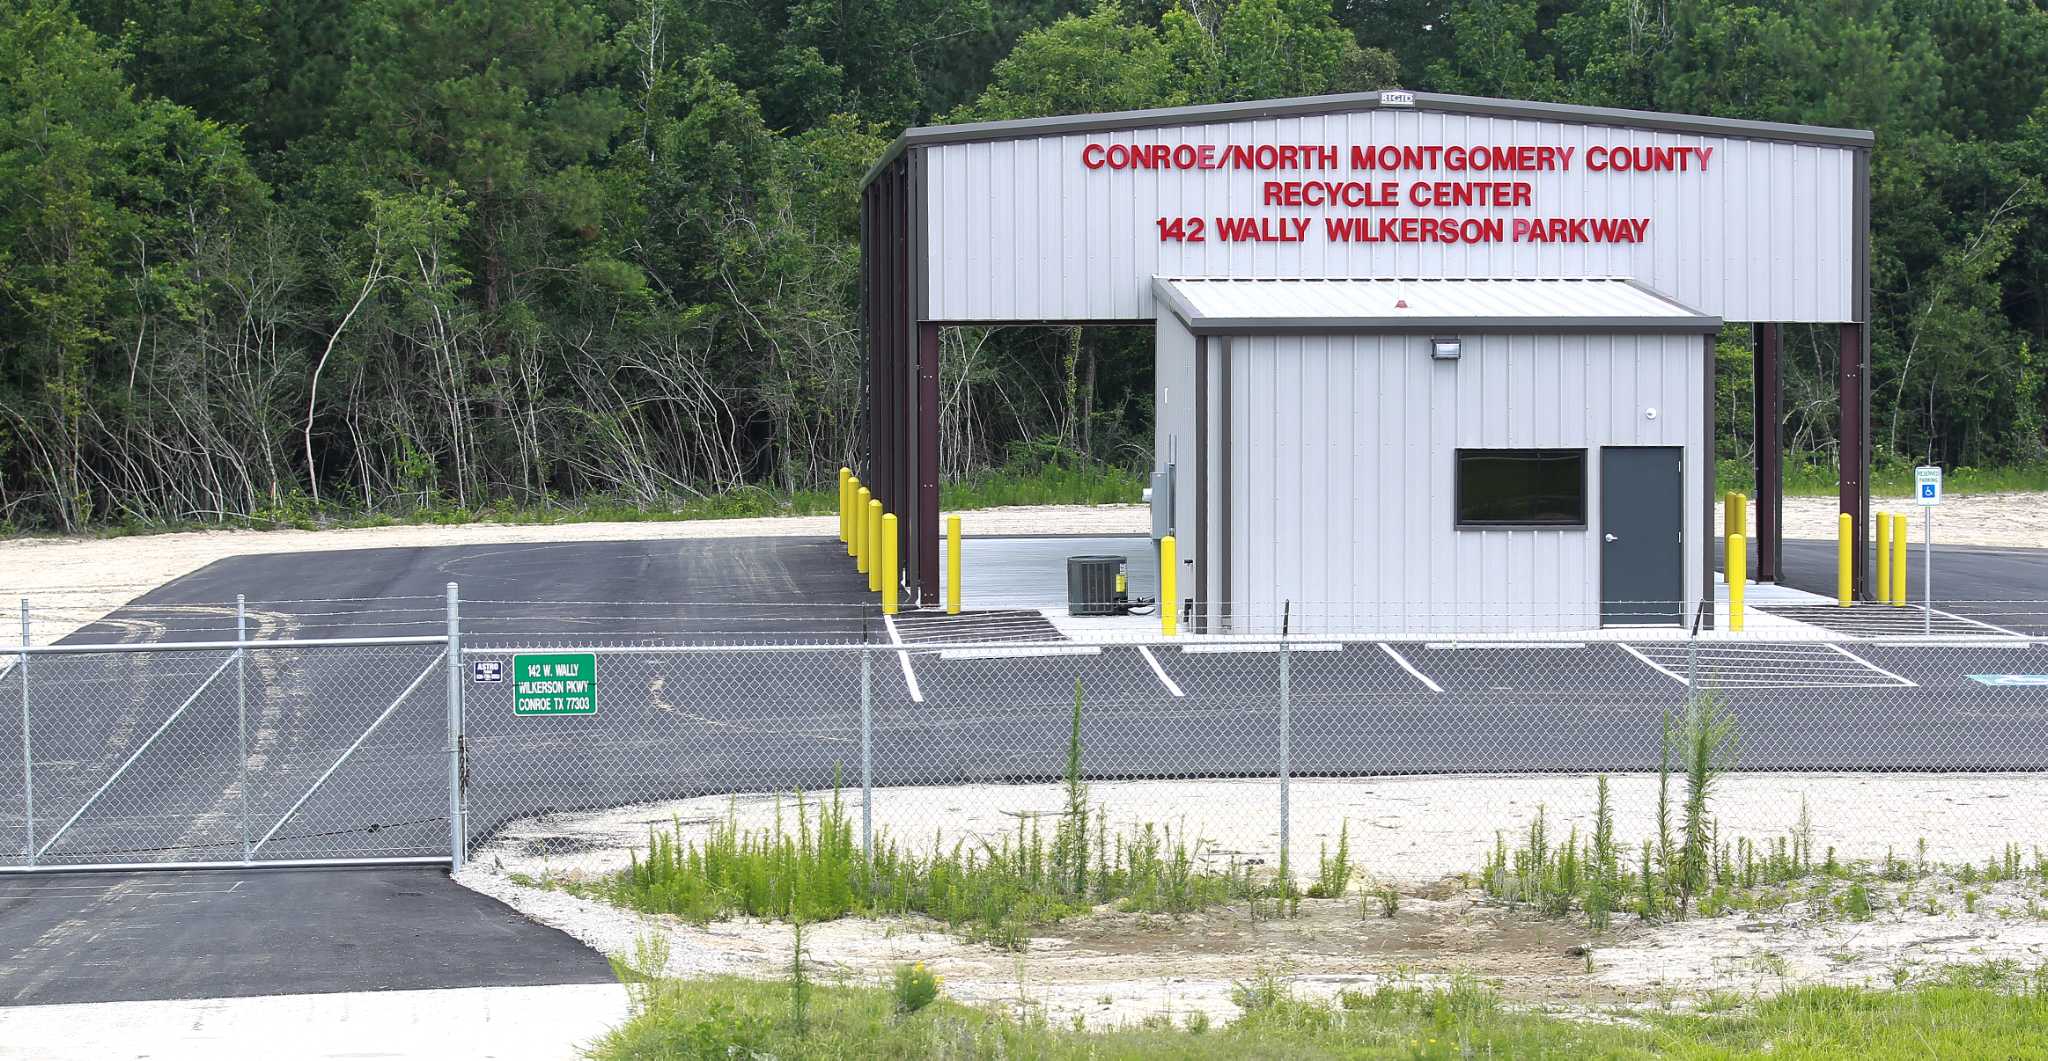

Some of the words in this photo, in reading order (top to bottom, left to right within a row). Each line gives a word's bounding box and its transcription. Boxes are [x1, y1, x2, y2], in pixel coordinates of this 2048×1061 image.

[1082, 144, 1339, 170] CONROE/NORTH
[1351, 145, 1575, 172] MONTGOMERY
[1586, 147, 1714, 172] COUNTY
[1264, 181, 1399, 207] RECYCLE
[1410, 181, 1532, 207] CENTER
[1157, 217, 1206, 243] 142
[1216, 218, 1311, 243] WALLY
[1326, 218, 1504, 243] WILKERSON
[1513, 218, 1650, 244] PARKWAY
[477, 663, 499, 671] ASTRO
[528, 664, 541, 677] 142
[543, 664, 553, 677] W.
[555, 664, 579, 677] WALLY
[518, 681, 564, 694] WILKERSON
[566, 680, 589, 693] PKWY
[518, 698, 551, 711] CONROE
[554, 698, 564, 710] TX
[566, 697, 590, 710] 77303
